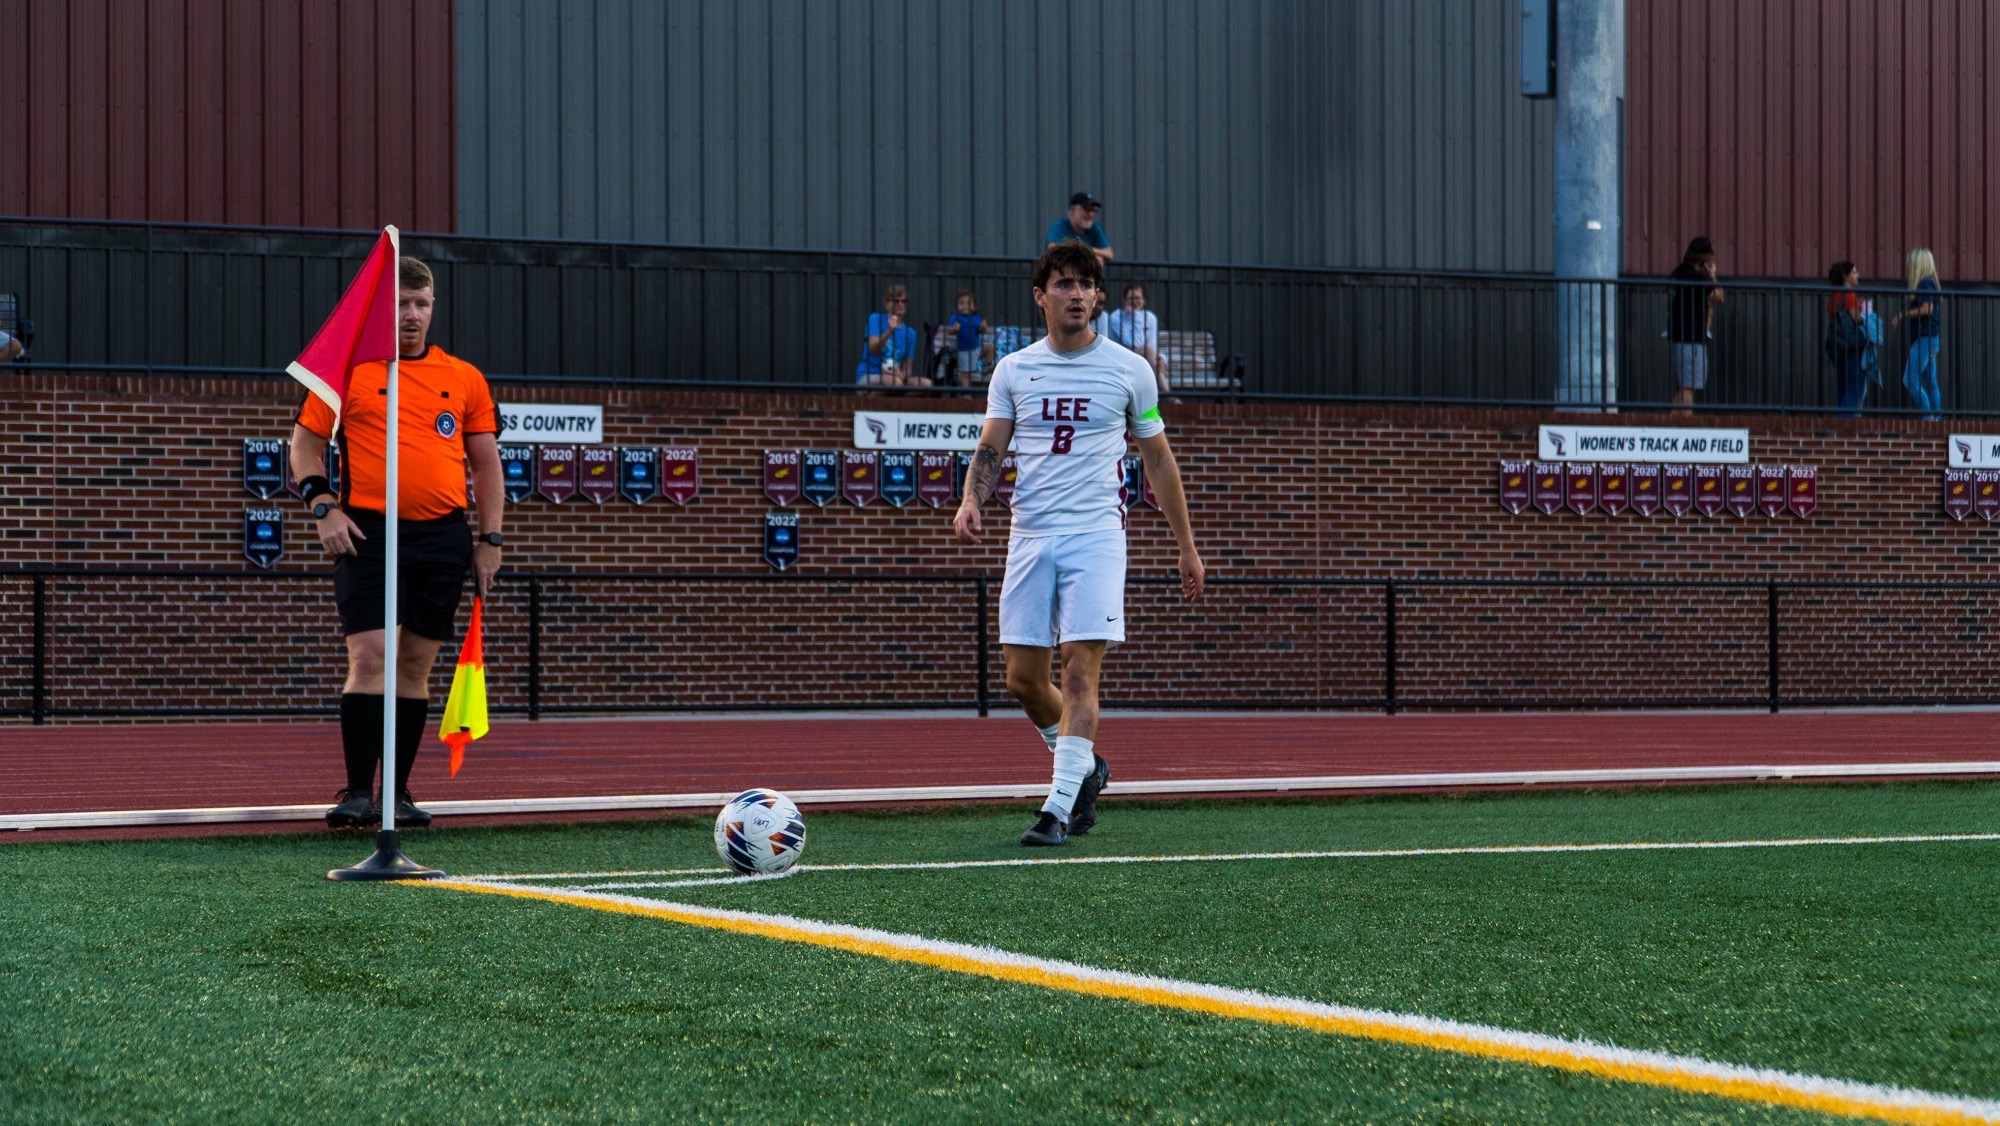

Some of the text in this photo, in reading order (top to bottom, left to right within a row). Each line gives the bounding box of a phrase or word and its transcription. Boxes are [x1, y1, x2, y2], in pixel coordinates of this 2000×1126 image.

[1041, 398, 1092, 422] LEE
[522, 415, 597, 432] COUNTRY
[903, 423, 952, 439] MEN'S
[1050, 425, 1075, 455] 8
[1580, 436, 1744, 454] WOMEN'S TRACK AND FIELD
[247, 441, 279, 453] 2016
[500, 448, 531, 461] 2019
[542, 449, 573, 461] 2020
[584, 450, 613, 461] 2021
[624, 450, 653, 462] 2021
[665, 450, 694, 461] 2022
[768, 453, 797, 465] 2015
[806, 454, 835, 466] 2015
[847, 453, 874, 464] 2016
[884, 455, 913, 467] 2016
[922, 456, 950, 467] 2017
[1503, 463, 1527, 474] 2017
[1536, 464, 1560, 475] 2018
[1569, 465, 1593, 476] 2019
[1601, 465, 1625, 476] 2019
[1633, 466, 1657, 477] 2020
[1665, 466, 1689, 477] 2021
[1697, 467, 1720, 478] 2021
[1729, 468, 1753, 479] 2022
[1760, 467, 1784, 478] 2022
[1791, 468, 1815, 479] 2023
[1947, 471, 1970, 482] 2016
[1976, 472, 1999, 482] 2019
[249, 510, 280, 521] 2022
[768, 516, 797, 527] 2022
